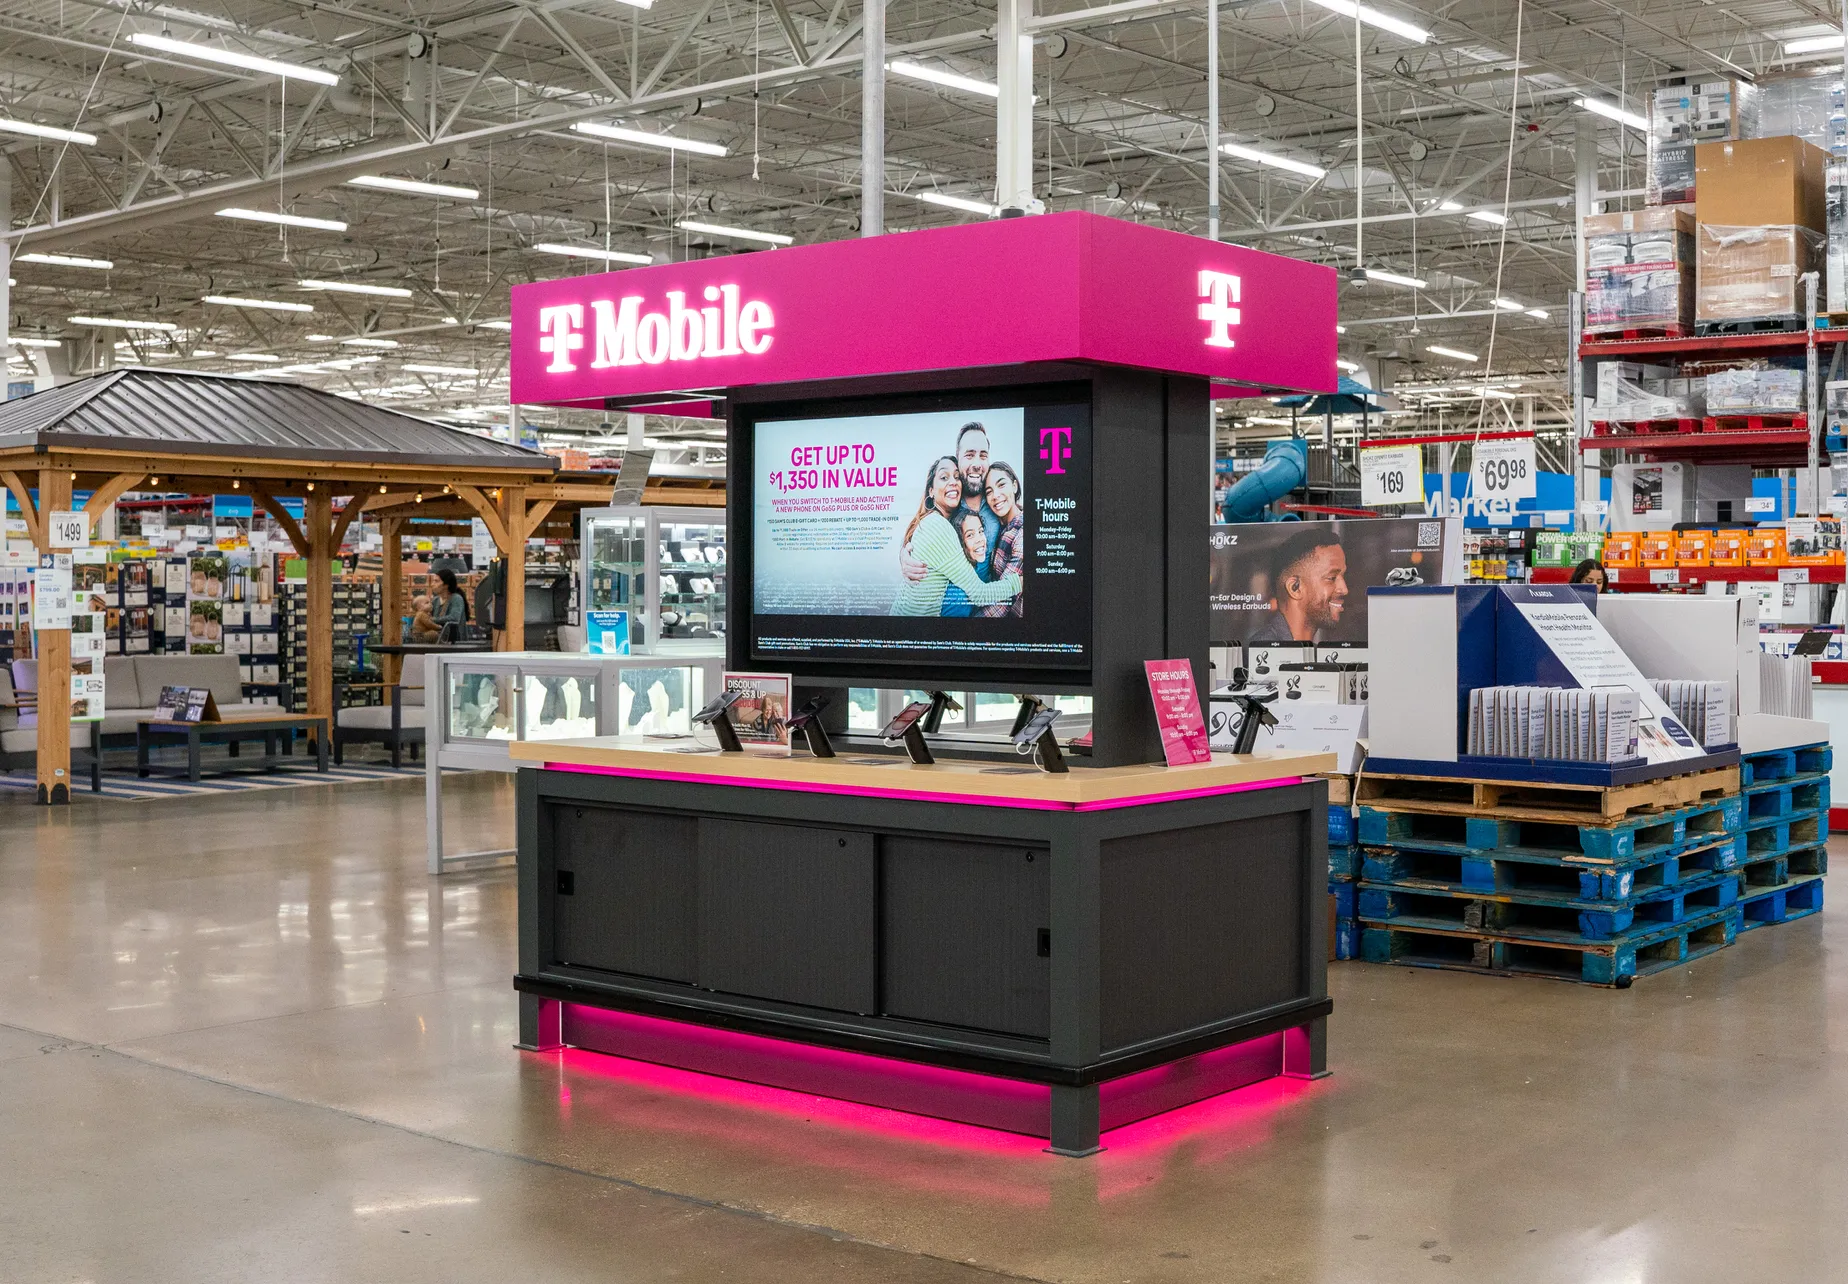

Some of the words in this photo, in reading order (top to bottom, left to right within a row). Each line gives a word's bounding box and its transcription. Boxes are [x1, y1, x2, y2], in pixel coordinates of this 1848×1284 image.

[1662, 150, 1687, 158] HYBRID
[1198, 270, 1241, 348] T
[590, 284, 775, 369] Mobile
[791, 446, 823, 466] GET
[826, 445, 849, 465] UP
[852, 443, 875, 464] TO
[1040, 427, 1072, 474] T
[769, 469, 818, 494] $1,350
[822, 469, 839, 488] IN
[843, 467, 897, 487] VALUE
[1376, 471, 1404, 493] $169
[1035, 498, 1076, 510] T-Mobile
[1042, 511, 1069, 522] hours
[56, 523, 81, 541] $1499
[1231, 593, 1255, 602] Design
[1242, 602, 1271, 610] Earbuds
[1151, 672, 1169, 681] STORE
[1170, 671, 1189, 680] HOURS
[728, 680, 761, 689] DISCOUNT
[750, 690, 756, 698] &
[757, 691, 767, 699] UP
